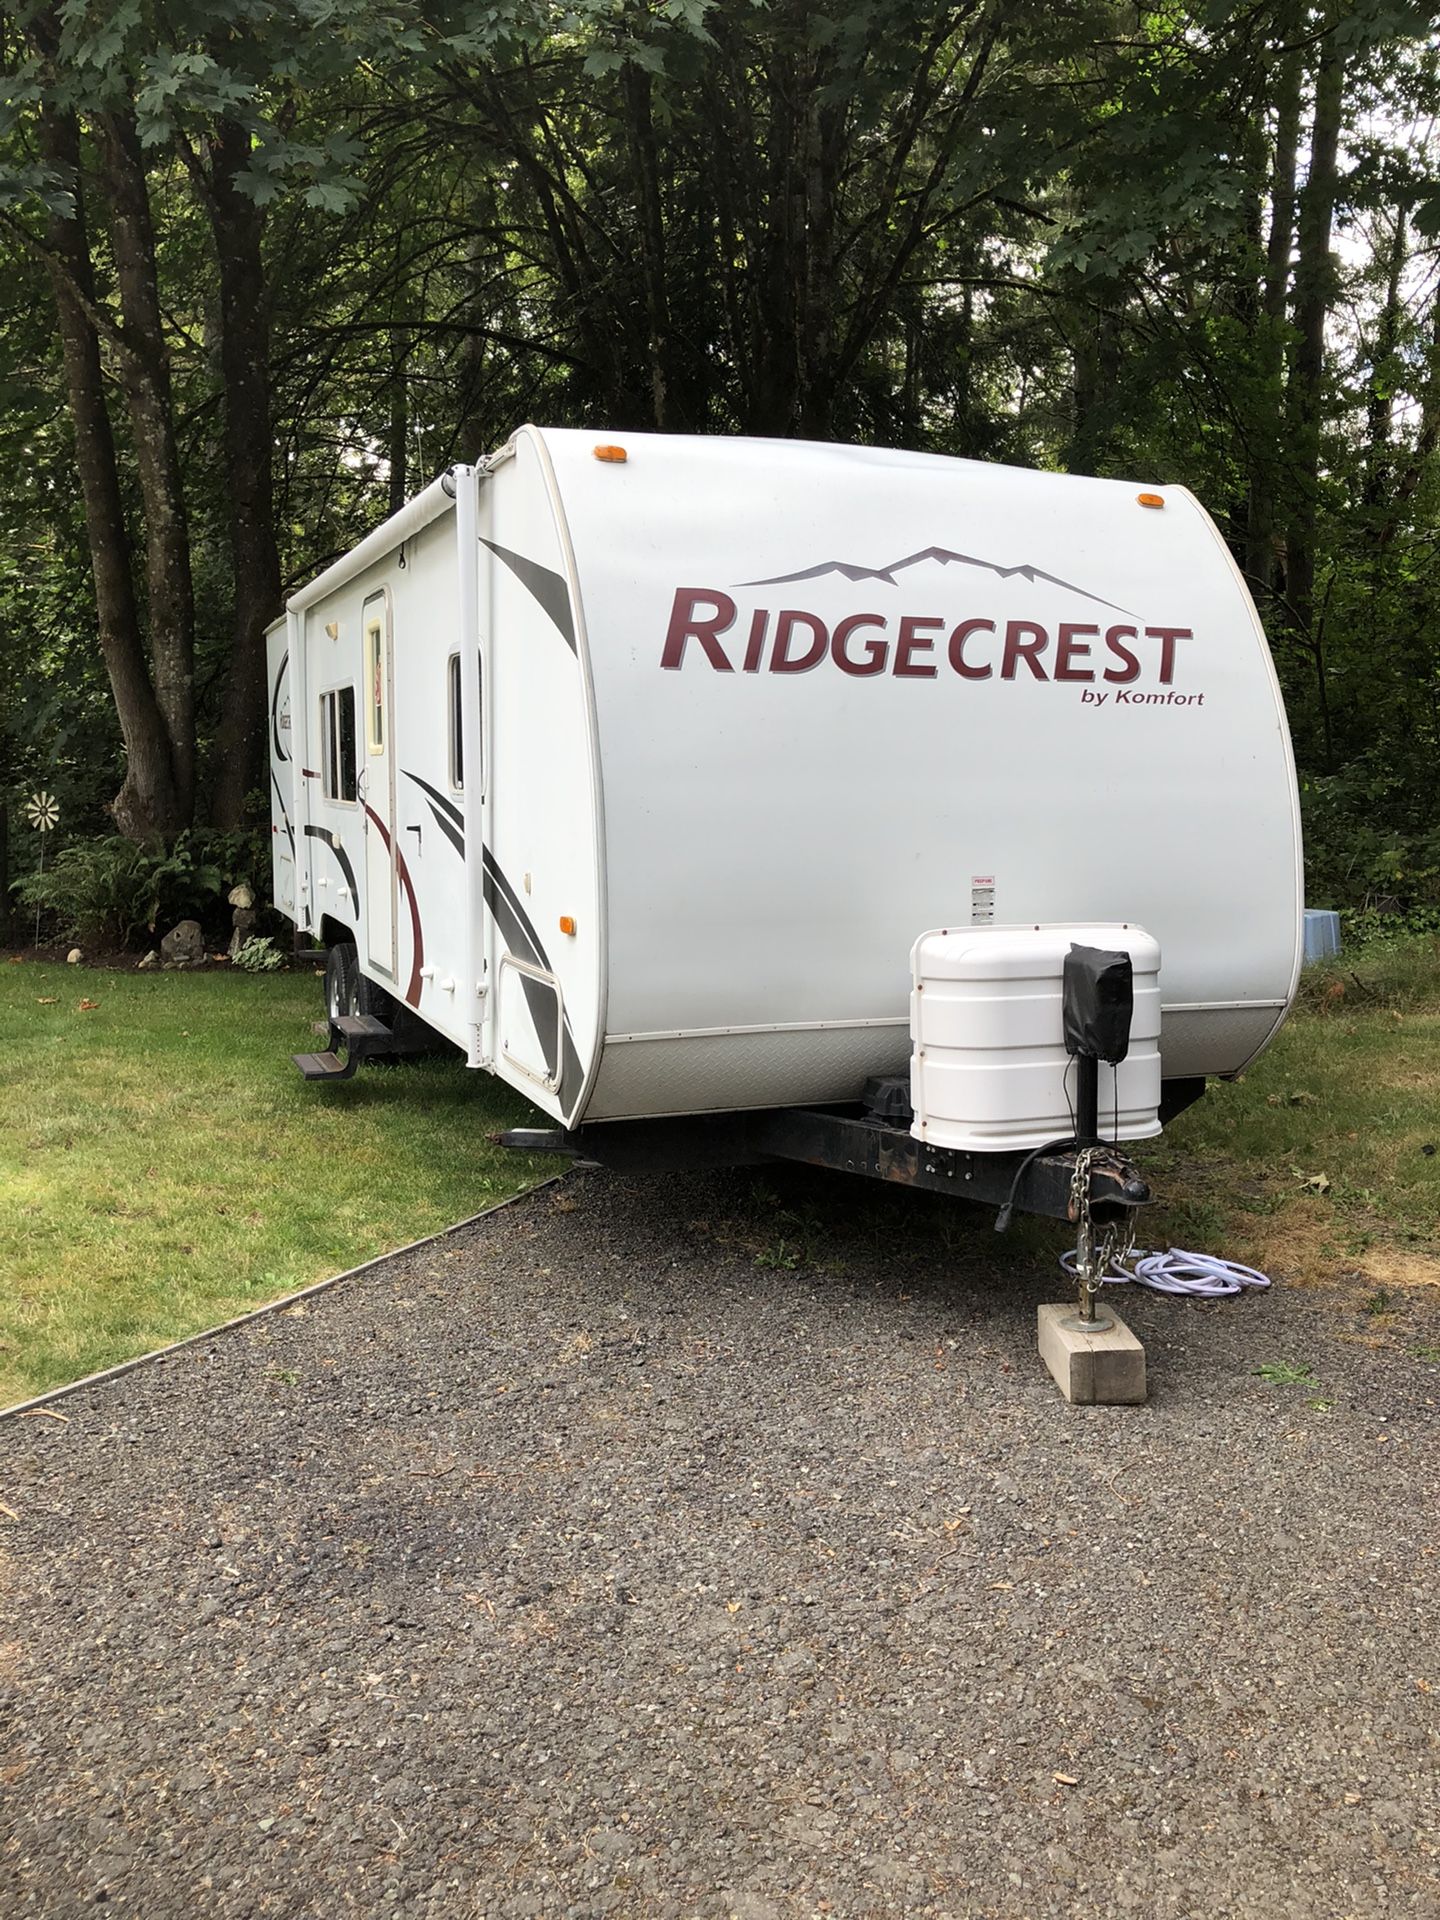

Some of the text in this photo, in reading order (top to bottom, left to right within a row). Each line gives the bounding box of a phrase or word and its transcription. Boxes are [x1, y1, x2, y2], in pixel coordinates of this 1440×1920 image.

[660, 587, 1194, 685] RIDGECREST
[1081, 689, 1205, 707] by Komfort
